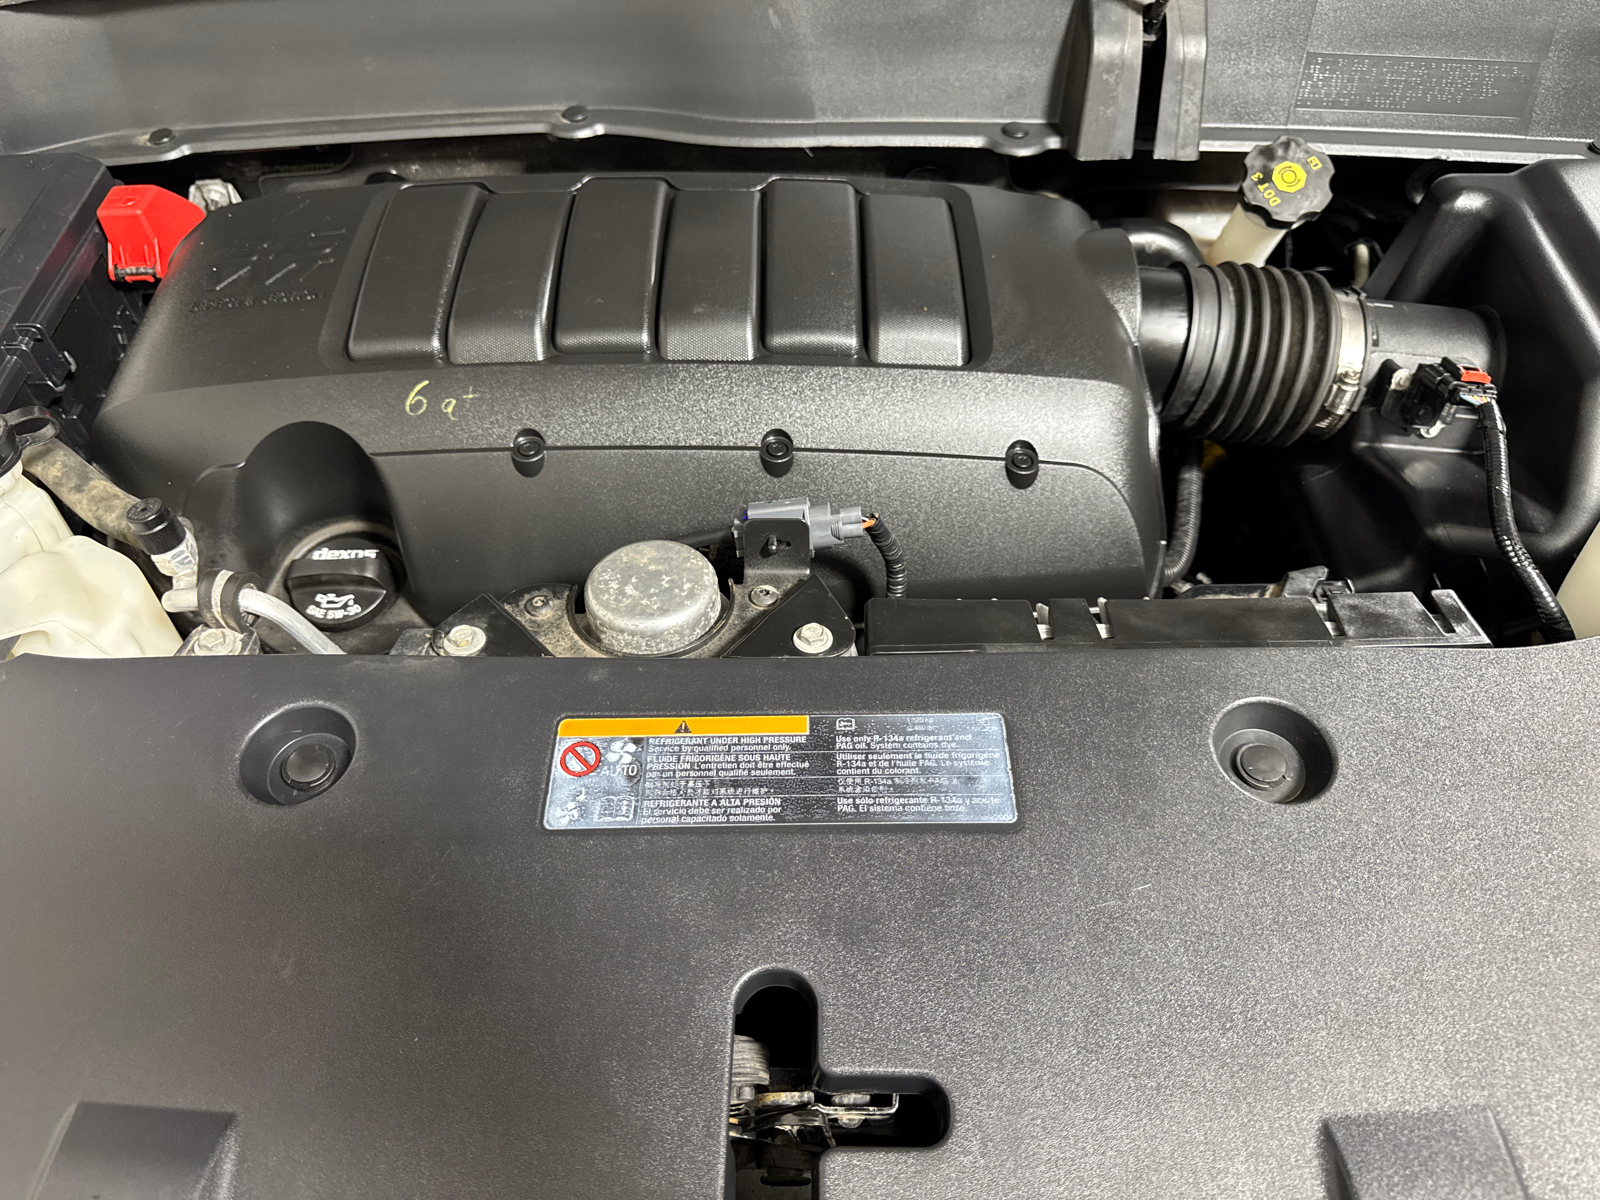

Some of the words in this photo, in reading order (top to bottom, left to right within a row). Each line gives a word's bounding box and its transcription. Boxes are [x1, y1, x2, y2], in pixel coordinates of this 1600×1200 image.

[1250, 171, 1264, 182] 3
[1257, 182, 1281, 207] DOT
[405, 379, 430, 416] 6
[305, 605, 327, 619] SAE
[325, 604, 362, 619] 5W-30
[648, 737, 708, 745] REFRIGERANT
[740, 736, 761, 744] HIGH
[835, 735, 852, 743] Use
[853, 735, 871, 744] only
[873, 734, 904, 742] R-134a
[905, 734, 952, 743] refrigerant
[647, 745, 680, 753] Service
[681, 745, 693, 753] by
[693, 744, 729, 753] qualified
[731, 744, 771, 752] personnel
[772, 743, 791, 752] only.
[835, 742, 853, 750] PAG
[870, 741, 901, 751] System
[902, 741, 939, 750] contains
[680, 753, 737, 762] FRIGORIGÈNE
[763, 753, 791, 761] HAUTE
[868, 752, 913, 760] seulement
[694, 762, 737, 770] L'entretien
[739, 761, 755, 769] doit
[775, 760, 810, 768] effectué
[919, 759, 938, 767] PAG.
[675, 769, 717, 778] personnel
[718, 768, 748, 777] qualifié
[750, 768, 796, 776] seulement.
[836, 767, 870, 775] contient
[871, 767, 882, 775] du
[884, 767, 921, 775] colorant.
[643, 798, 709, 808] REFRIGERANTE
[711, 798, 720, 806] A
[720, 797, 741, 806] ALTA
[743, 796, 781, 806] PRESIÓN
[836, 797, 854, 805] Use
[855, 796, 874, 804] sólo
[875, 796, 928, 806] refrigerante
[930, 796, 963, 805] R-134a
[688, 806, 710, 815] debe
[727, 805, 766, 814] realizado
[767, 806, 782, 815] por
[837, 804, 857, 813] PAG.
[859, 804, 867, 812] El
[869, 804, 903, 812] sistema
[904, 804, 943, 812] contiene
[640, 814, 680, 825] personal
[681, 814, 727, 824] capacitado
[729, 813, 776, 823] solamente.
